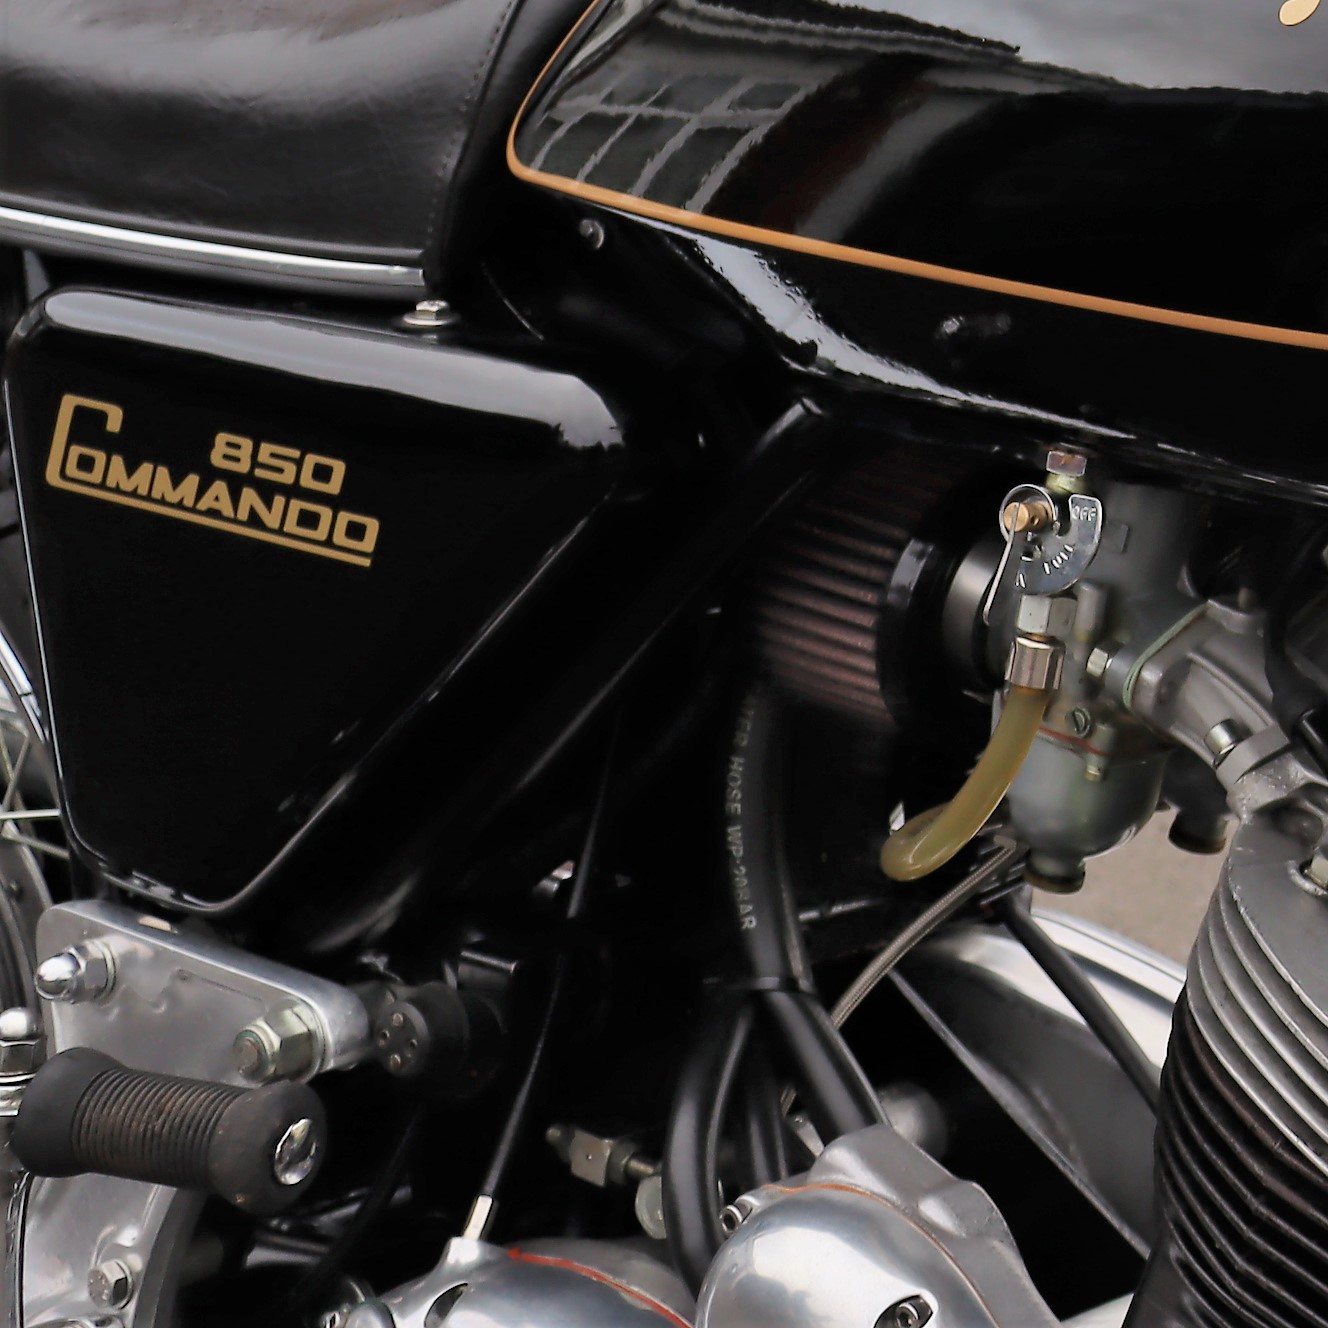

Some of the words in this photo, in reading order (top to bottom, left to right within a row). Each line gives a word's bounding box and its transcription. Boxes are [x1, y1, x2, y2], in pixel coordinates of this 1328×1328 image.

[45, 393, 380, 566] COMMANDO
[210, 432, 346, 495] 850
[725, 755, 746, 814] HOSE
